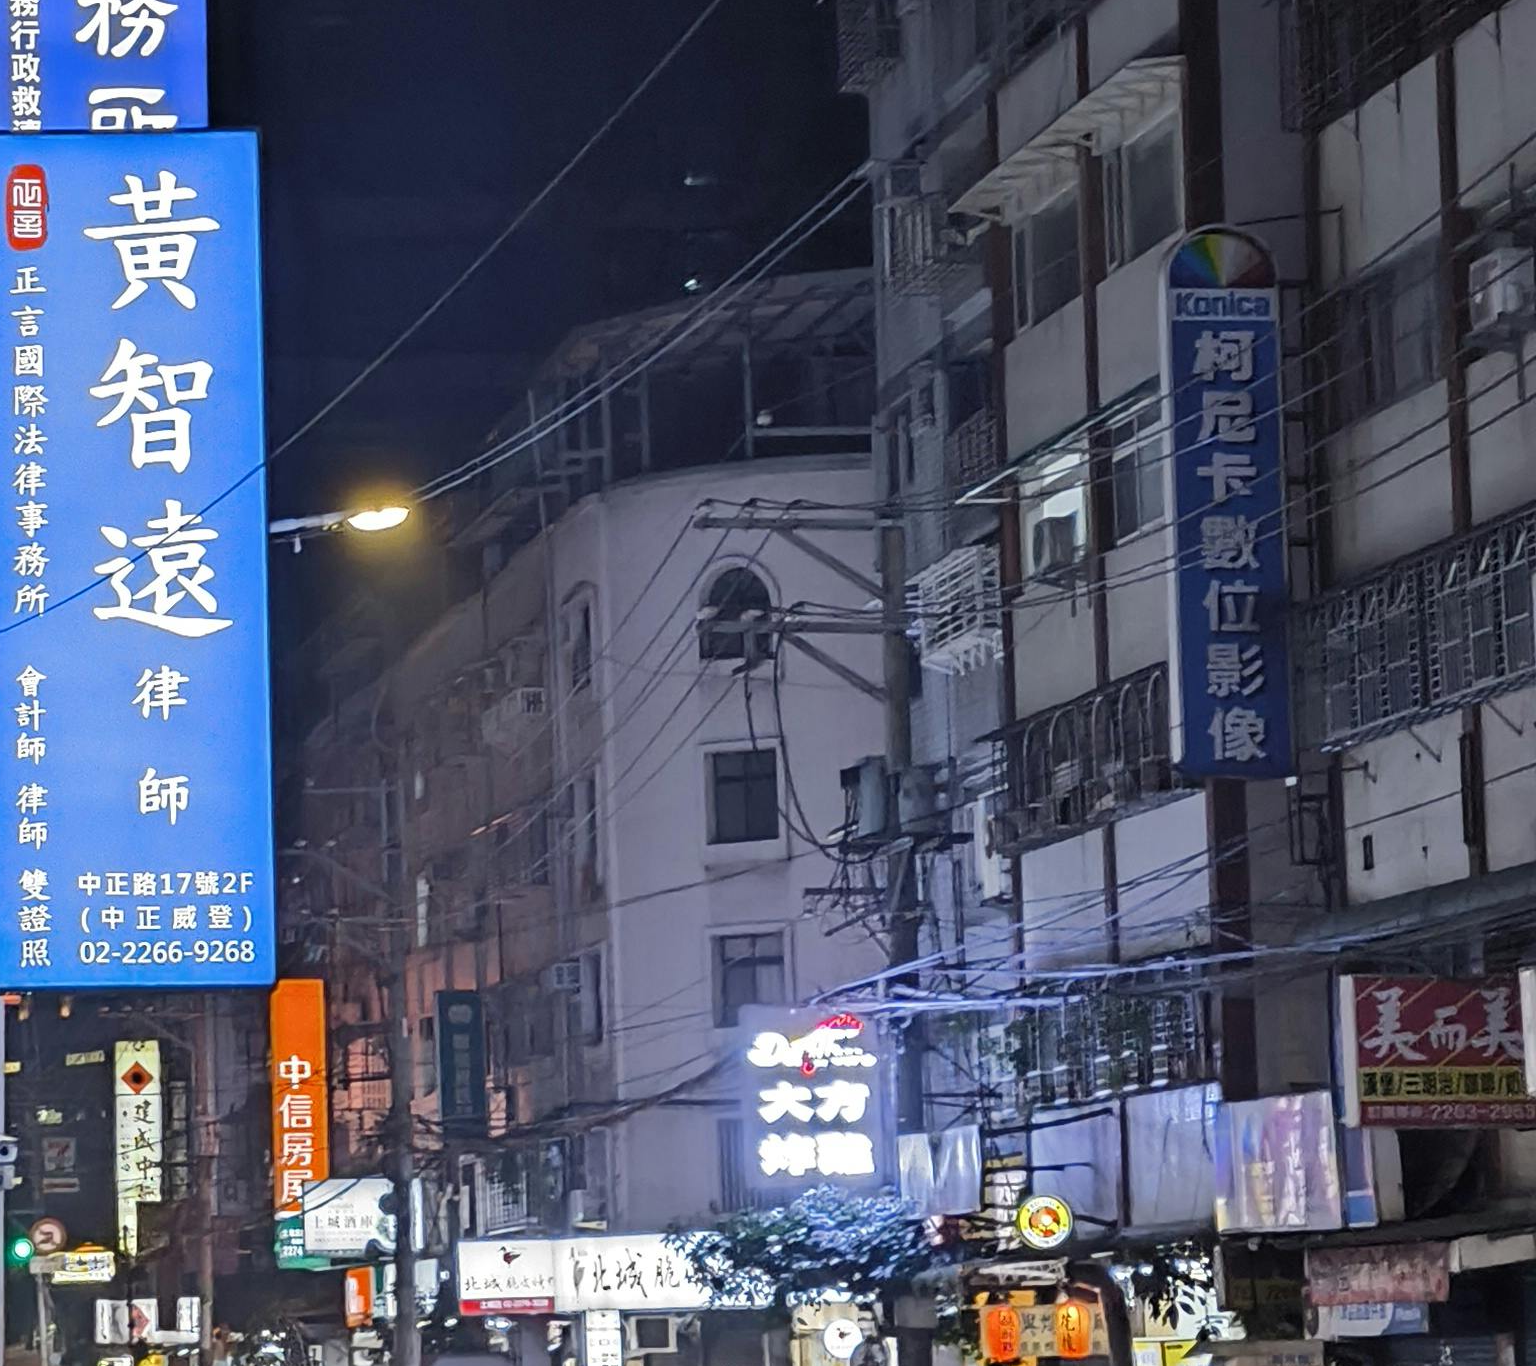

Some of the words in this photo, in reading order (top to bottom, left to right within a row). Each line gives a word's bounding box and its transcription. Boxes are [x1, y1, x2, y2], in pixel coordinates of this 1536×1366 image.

[1175, 290, 1271, 317] Konica
[8, 265, 50, 617] 正言國際法律事務所
[83, 170, 234, 638] 黃智遠
[1193, 329, 1268, 763] 柯尼卡數位影像
[14, 664, 48, 766] 會計師
[131, 664, 190, 825] 律師
[16, 781, 49, 850] 律師
[18, 868, 52, 968] 雙證照
[77, 870, 255, 898] 中正路17號2F
[79, 904, 254, 934] (中正威登)
[79, 940, 256, 965] 02-2266-9268
[279, 1054, 315, 1208] 中信房屋
